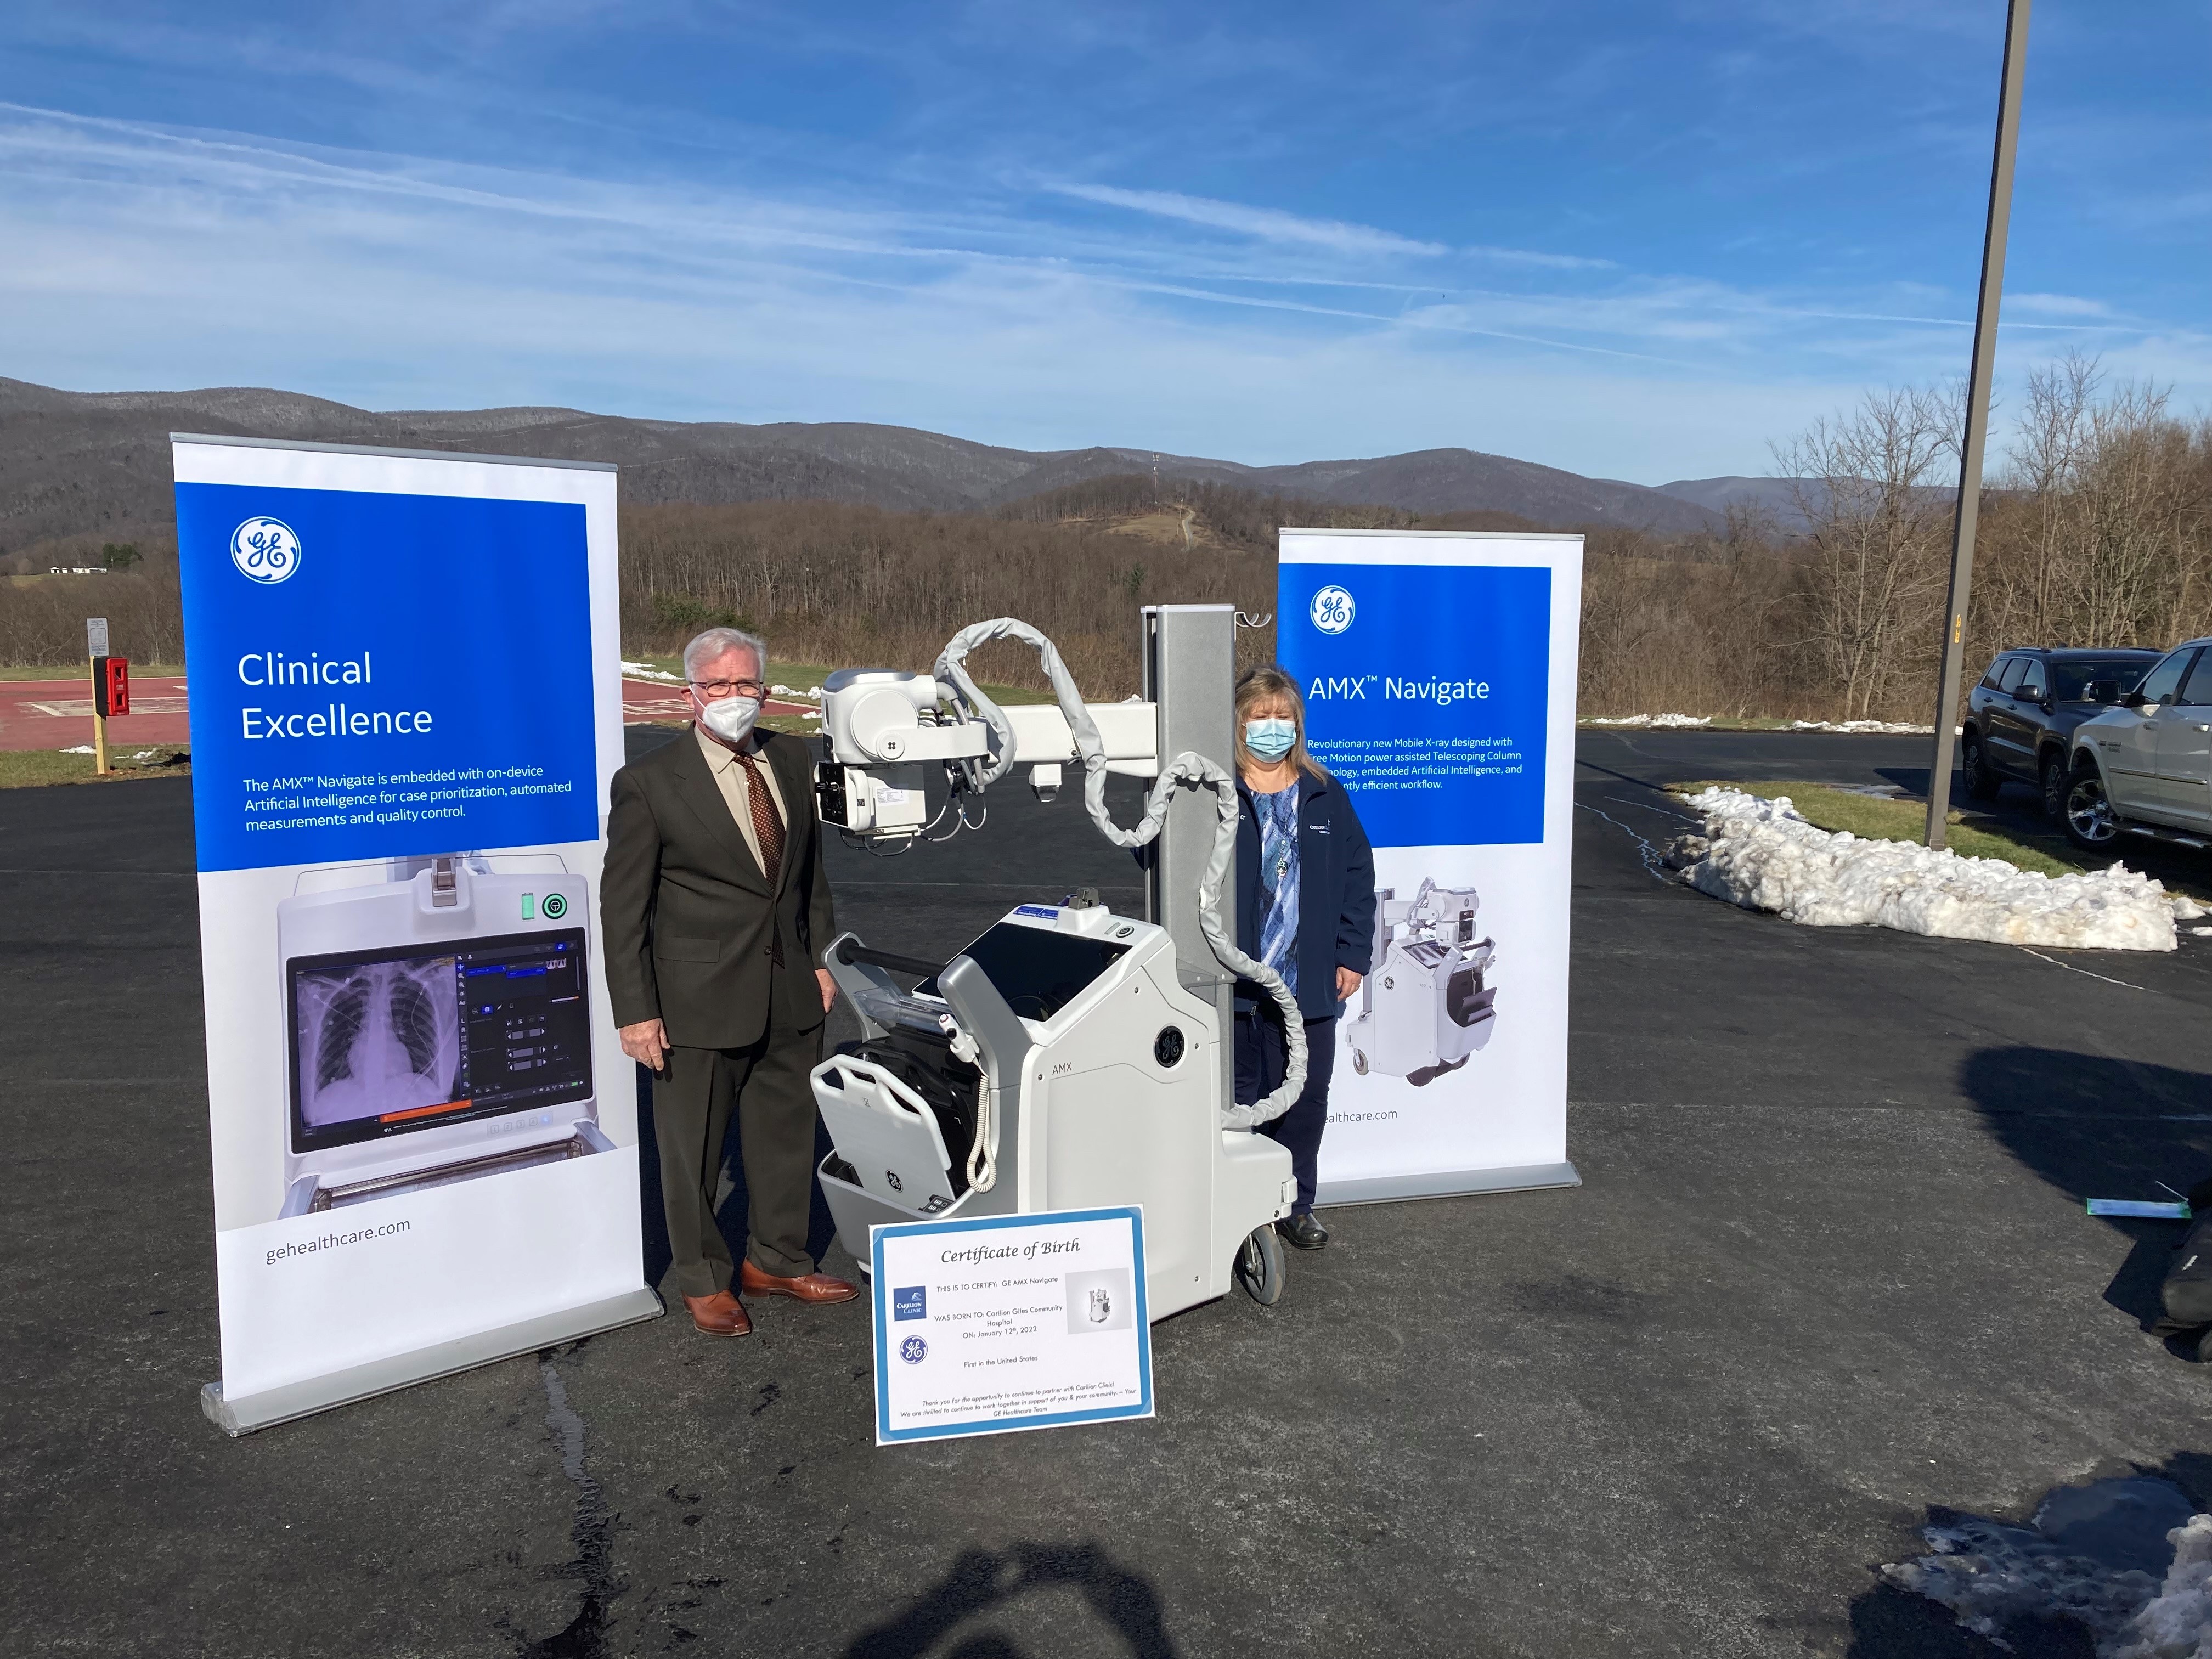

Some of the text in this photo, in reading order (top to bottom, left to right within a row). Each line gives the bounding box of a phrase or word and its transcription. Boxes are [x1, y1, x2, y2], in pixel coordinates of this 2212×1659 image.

[238, 652, 371, 686] Clinical
[1386, 676, 1489, 706] Navigate
[243, 704, 432, 738] Excellence
[1307, 739, 1371, 750] Revolutionary
[1395, 738, 1423, 747] Mobile
[1426, 738, 1449, 749] X-ray
[1452, 737, 1491, 749] designed
[1493, 737, 1513, 746] with
[1309, 751, 1521, 764] ree Motion power assisted Telescoping Column
[1328, 764, 1522, 778] nology, embedded Artificial Intelligence, and
[243, 778, 269, 792] The
[317, 774, 375, 789] Navigate
[377, 772, 388, 785] is
[390, 769, 455, 783] embedded
[458, 767, 484, 780] with
[487, 765, 543, 779] on-device
[1362, 780, 1398, 789] efficient
[1400, 779, 1443, 789] workflow.
[245, 780, 571, 812] Artificial Intelligence for case prioritization, automated
[246, 805, 466, 831] measurements and quality control.
[1052, 1062, 1072, 1075] AMX
[1324, 1110, 1397, 1124] ealthcare.com
[266, 1220, 410, 1265] gehealthcare.com
[941, 1238, 1081, 1265] Certificate of Birth
[987, 1318, 1012, 1327] Hospital
[997, 1356, 1017, 1364] United
[972, 1393, 1003, 1402] opportunity
[1028, 1397, 1048, 1406] support
